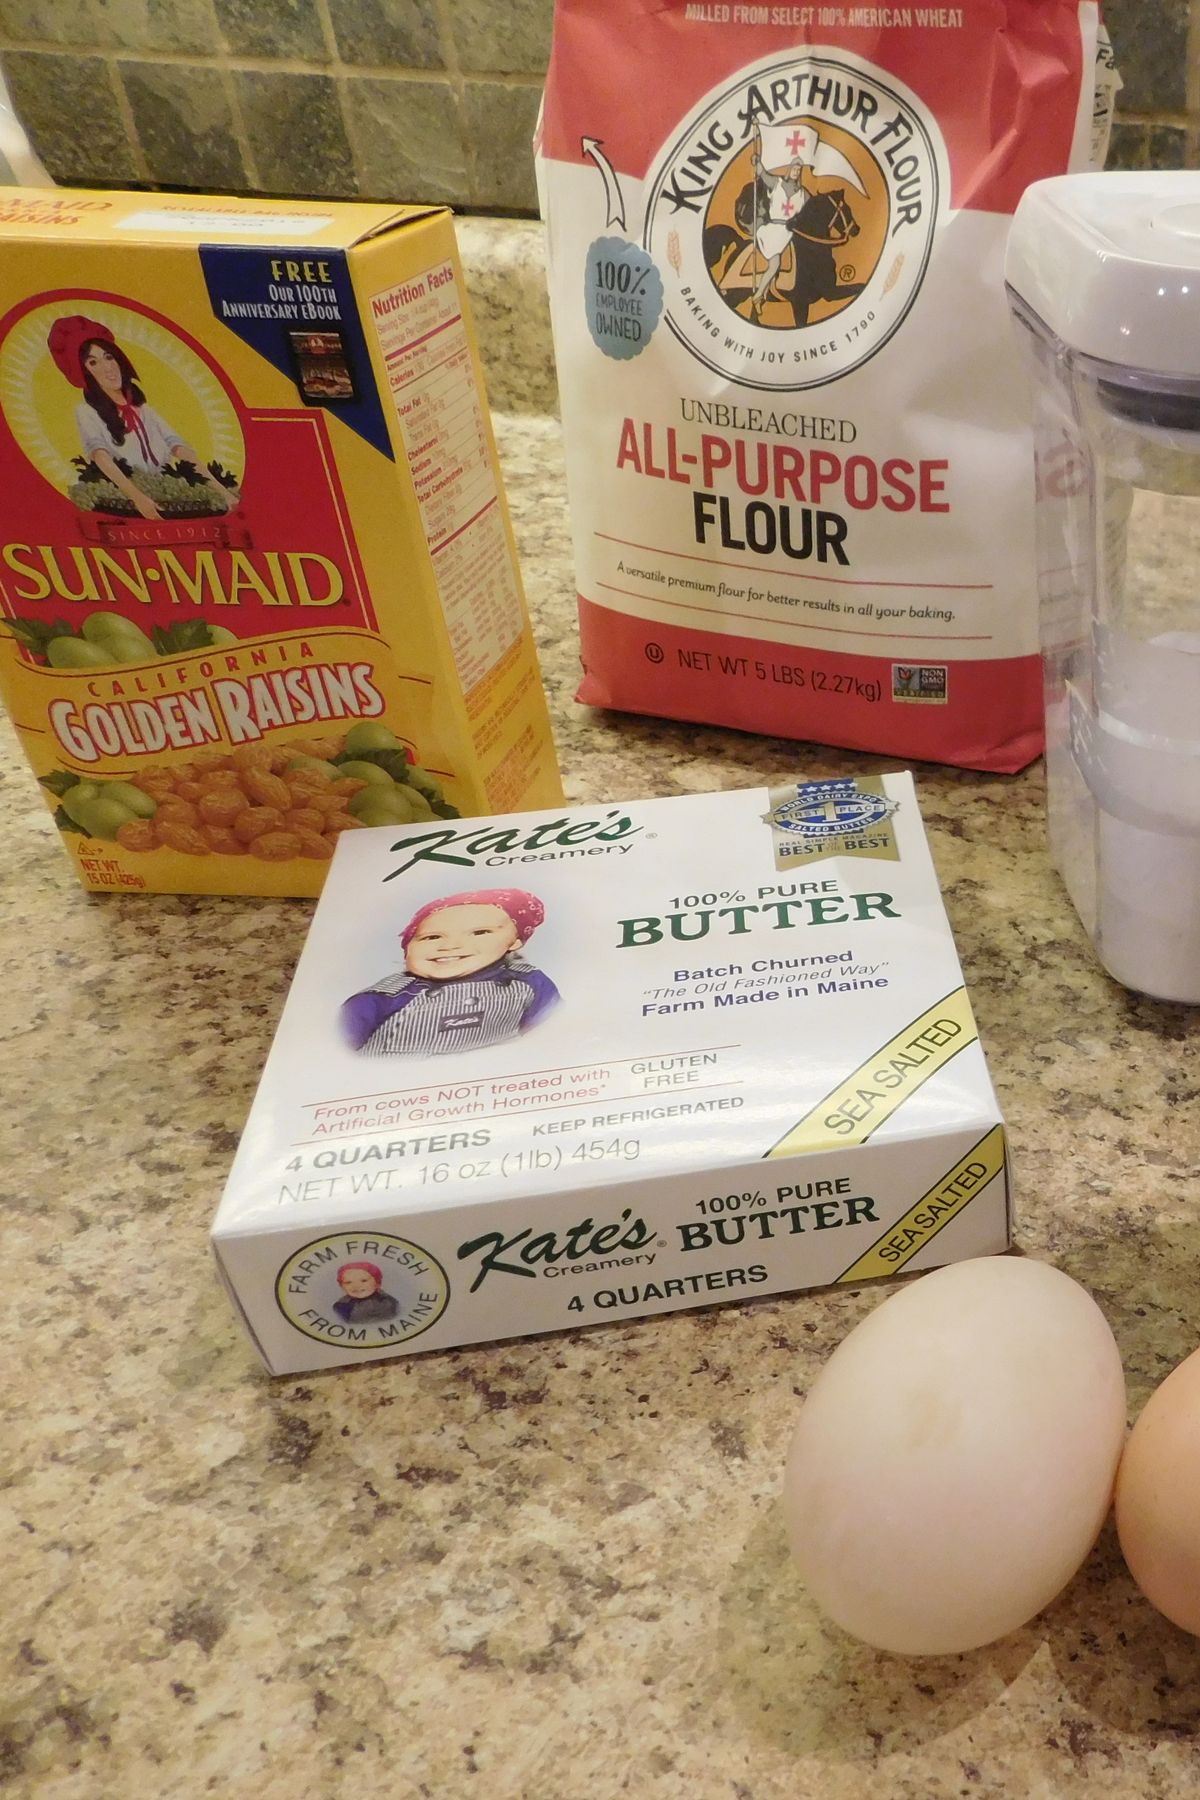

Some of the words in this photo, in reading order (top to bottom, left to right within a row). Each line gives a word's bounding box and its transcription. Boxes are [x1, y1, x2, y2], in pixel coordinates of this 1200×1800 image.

[684, 3, 730, 24] MILLED
[733, 4, 768, 25] FROM
[771, 6, 814, 26] SELECT
[817, 7, 846, 26] 100%
[848, 7, 912, 28] AMERICAN
[915, 8, 963, 28] WHEAT
[660, 121, 735, 216] KING
[737, 73, 879, 140] ARTHUR
[871, 112, 922, 238] FLOUR
[270, 260, 333, 283] FREE
[595, 260, 650, 296] 100%
[372, 282, 425, 318] Nutrition
[426, 267, 454, 292] Facts
[596, 292, 643, 316] EMPLOYEE
[595, 311, 642, 342] OWNED
[681, 286, 719, 337] BAKING
[724, 335, 754, 359] WITH
[760, 351, 785, 363] JOY
[794, 340, 838, 362] SINCE
[845, 311, 876, 344] 1790
[389, 363, 414, 389] Calories
[680, 397, 857, 444] UNBLEACHED
[616, 417, 951, 515] ALL-PURPOSE
[107, 529, 166, 542] SINCE
[175, 527, 221, 539] 1912
[692, 491, 851, 566] FLOUR
[616, 560, 626, 572] A
[626, 566, 666, 584] versatile
[667, 574, 717, 593] premium
[716, 582, 745, 599] flour
[747, 587, 765, 602] for
[767, 590, 801, 607] better
[803, 598, 841, 613] results
[843, 602, 855, 615] in
[857, 602, 873, 616] all
[875, 608, 906, 621] your
[908, 605, 956, 621] baking.
[87, 641, 316, 698] CALIFORNIA
[678, 648, 713, 671] NET
[719, 655, 749, 676] WT
[755, 662, 767, 680] 5
[772, 663, 805, 687] LBS
[811, 669, 882, 702] (2.27kg)
[921, 669, 944, 677] NON
[49, 690, 219, 762] GOLDEN
[220, 663, 387, 746] RAISINS
[781, 796, 815, 812] WORLD
[817, 792, 848, 800] DAIRY
[851, 793, 878, 802] EXPO
[781, 808, 820, 820] FIRST
[839, 804, 882, 813] PLACE
[788, 823, 830, 832] SALTED
[833, 817, 876, 830] BUTTER
[80, 859, 100, 872] NET
[101, 859, 125, 873] WT.
[381, 809, 644, 883] Kate's
[484, 843, 635, 868] Creamery
[779, 843, 826, 857] BEST
[844, 838, 890, 850] BEST
[669, 889, 746, 909] 100%
[757, 879, 838, 899] PURE
[615, 892, 903, 948] BUTTER
[673, 963, 743, 982] Batch
[751, 950, 854, 973] Churned
[694, 980, 727, 995] Old
[734, 967, 832, 989] Fashioned
[642, 998, 705, 1017] Farm
[713, 989, 780, 1008] Made
[787, 986, 809, 999] in
[816, 976, 890, 996] Maine
[630, 1052, 719, 1075] GLUTEN
[643, 1070, 700, 1089] FREE
[823, 1088, 888, 1136] SEA
[872, 1018, 962, 1090] SALTED
[313, 1104, 367, 1120] From
[374, 1094, 430, 1111] cows
[437, 1084, 486, 1102] NOT
[490, 1074, 564, 1096] treated
[569, 1067, 612, 1087] with
[311, 1115, 401, 1136] Artificial
[408, 1099, 486, 1124] Growth
[532, 1118, 587, 1137] KEEP
[591, 1096, 745, 1128] REFRIGERATED
[284, 1154, 303, 1173] 4
[312, 1128, 492, 1170] QUARTERS
[277, 1176, 337, 1206] NET
[350, 1168, 402, 1195] WT.
[418, 1164, 451, 1186] 16
[459, 1158, 491, 1180] oz
[499, 1145, 564, 1178] (1lb)
[571, 1137, 642, 1162] 454g
[695, 1190, 768, 1216] 100%
[776, 1177, 852, 1203] PURE
[878, 1228, 923, 1263] SEA
[914, 1161, 988, 1230] SALTED
[676, 1196, 880, 1253] BUTTER
[289, 1246, 339, 1295] FARM
[345, 1240, 430, 1277] FRESH
[456, 1207, 660, 1294] Kate's
[542, 1252, 657, 1279] Creamery
[567, 1295, 585, 1313] 4
[592, 1264, 770, 1309] QUARTERS
[298, 1308, 368, 1341] FROM
[378, 1291, 439, 1339] MAINE
